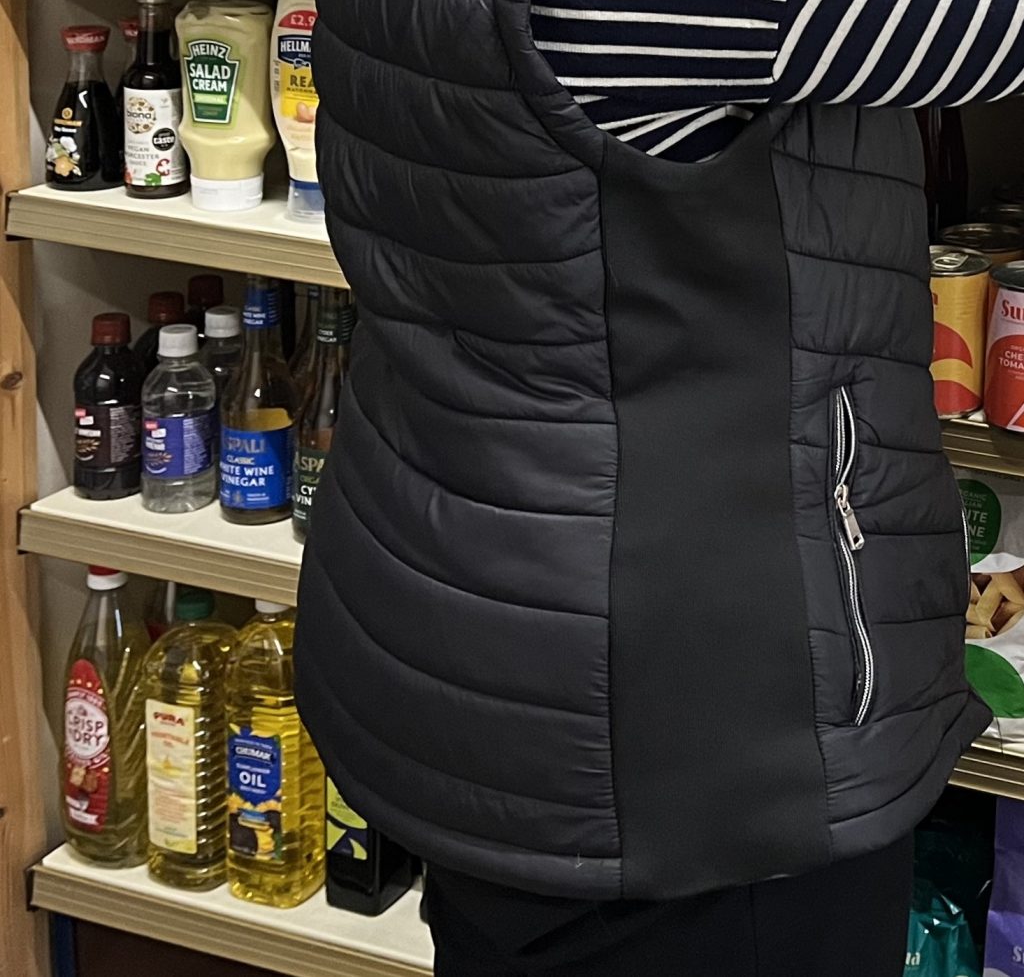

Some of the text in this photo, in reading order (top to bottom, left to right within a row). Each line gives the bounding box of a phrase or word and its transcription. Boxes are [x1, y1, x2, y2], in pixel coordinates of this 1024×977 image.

[192, 43, 226, 59] HEINZ
[190, 62, 231, 80] SALAD
[192, 79, 227, 92] CREAM
[244, 465, 274, 476] WINE
[222, 474, 265, 487] VINEGAR
[239, 772, 267, 788] OIL
